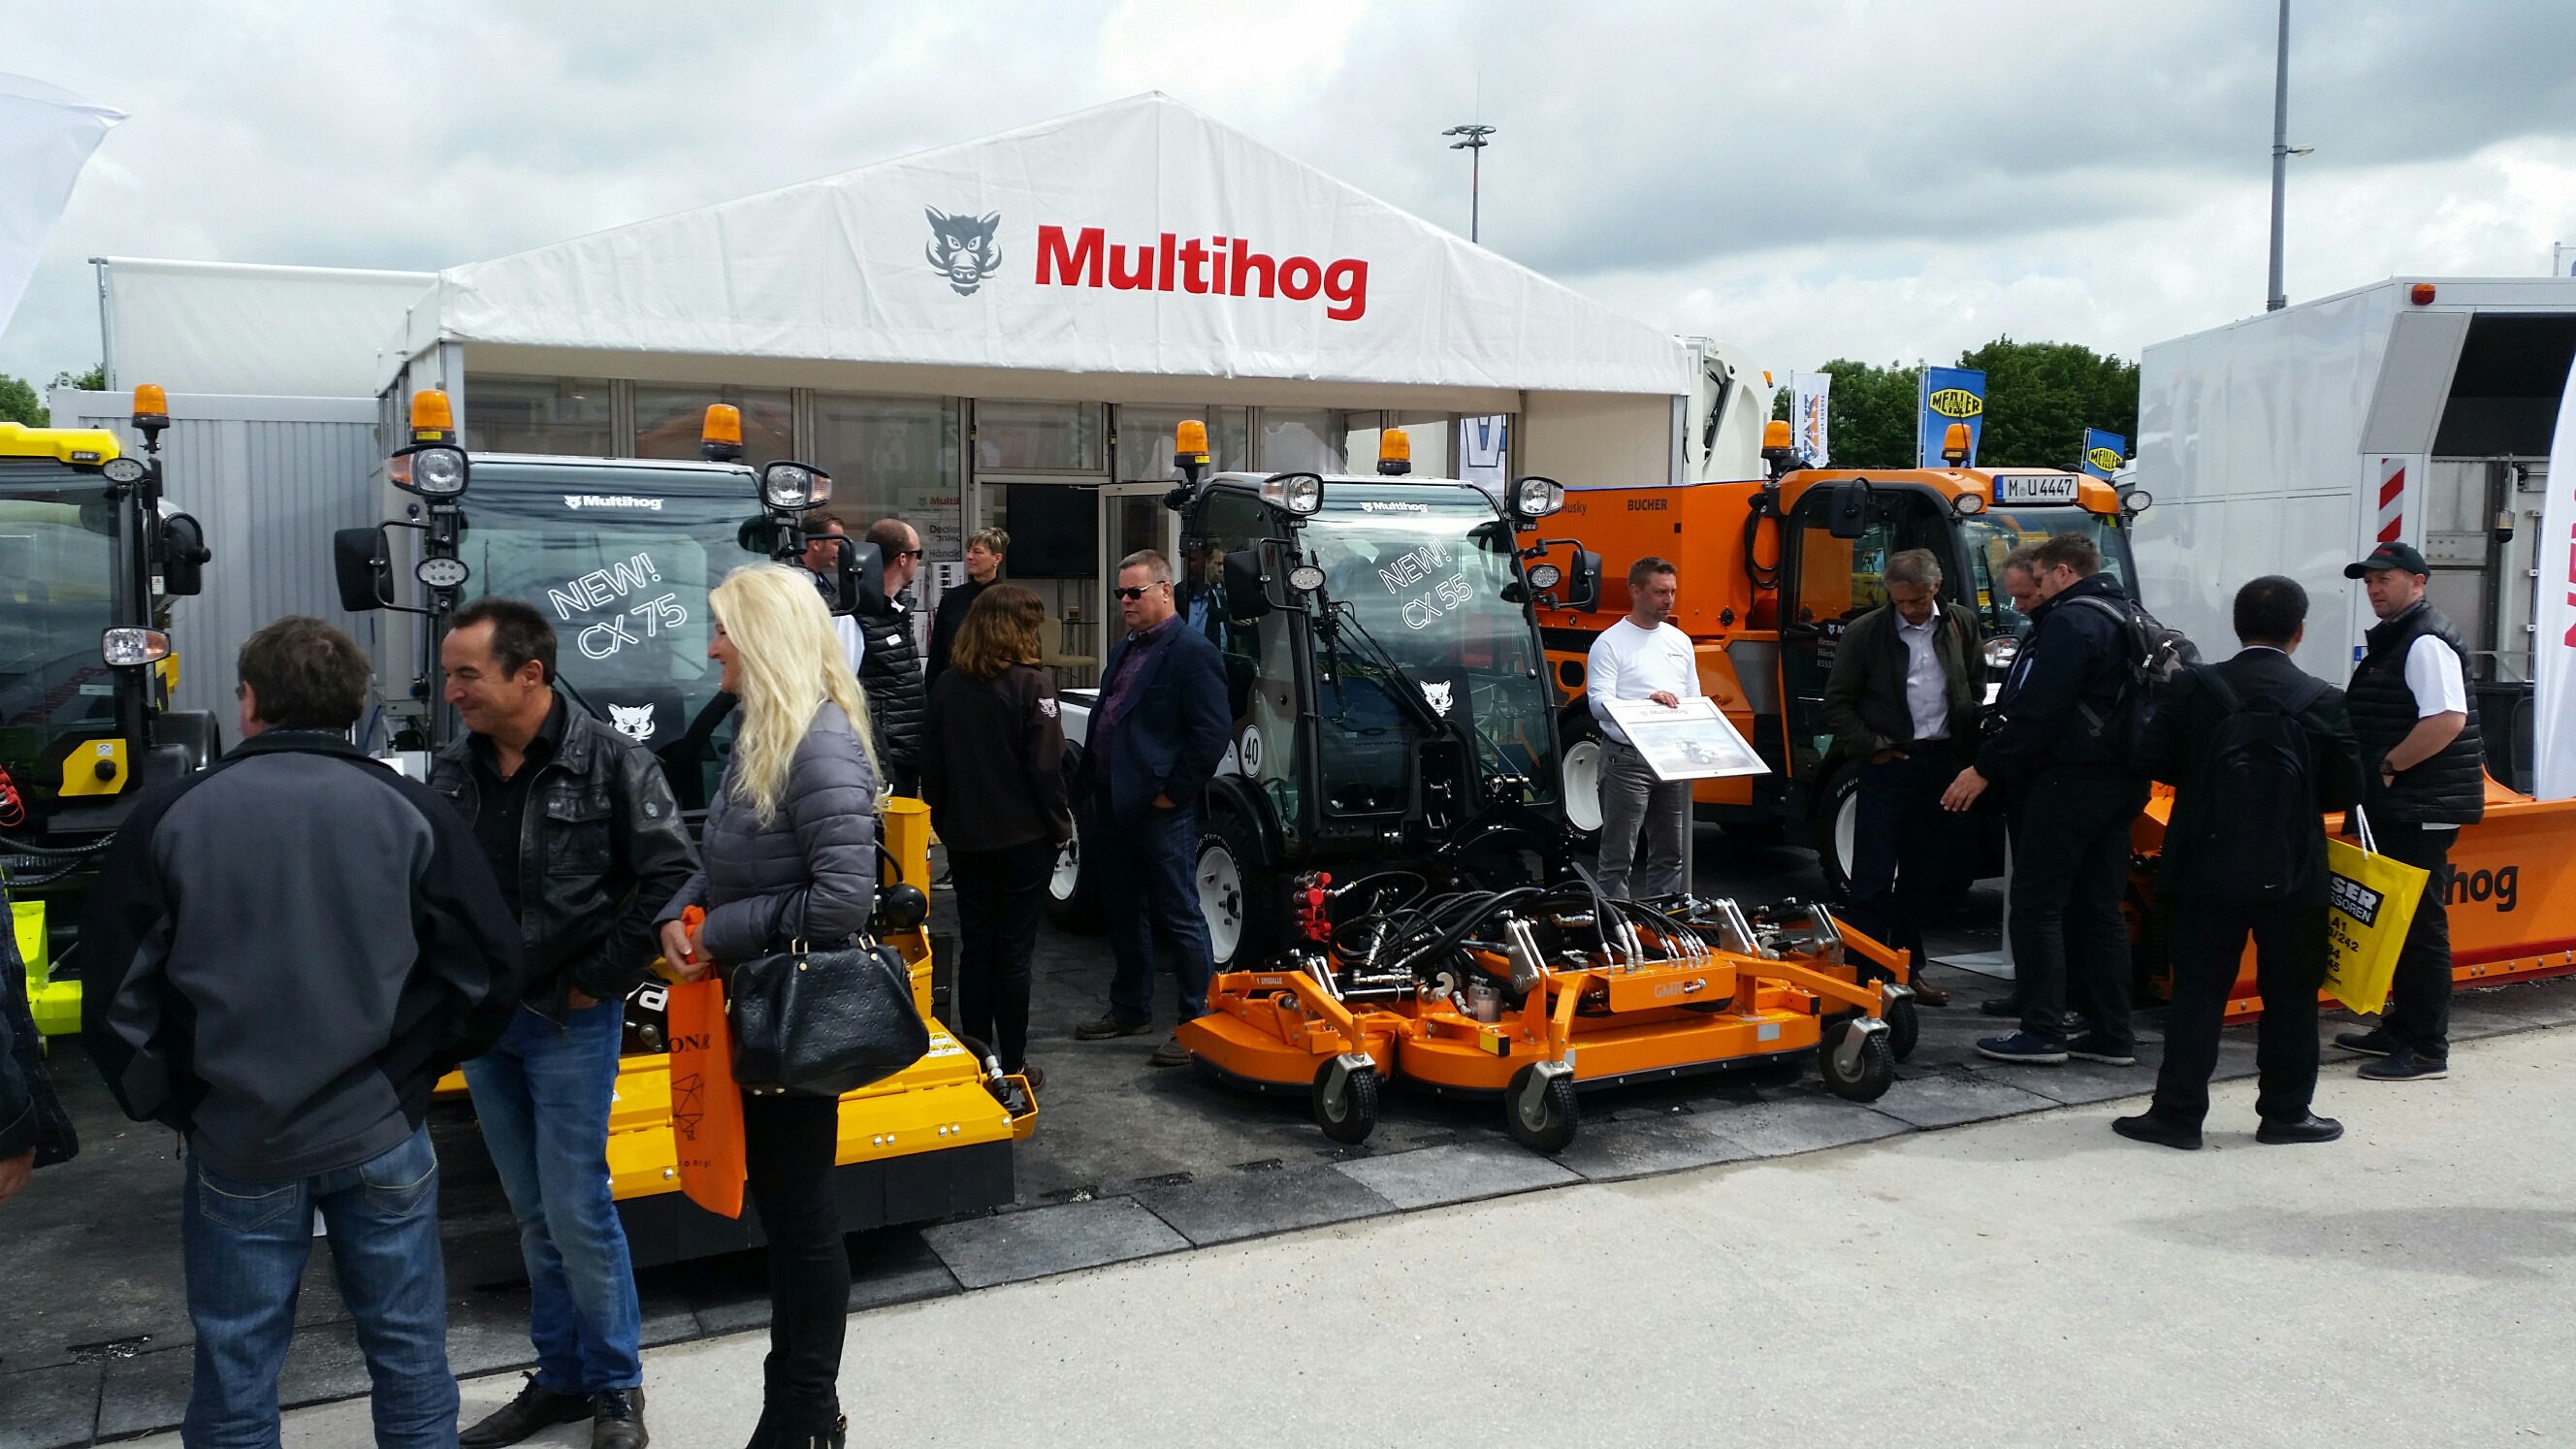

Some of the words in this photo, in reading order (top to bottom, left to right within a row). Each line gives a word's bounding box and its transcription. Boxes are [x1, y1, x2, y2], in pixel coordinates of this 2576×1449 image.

[1035, 224, 1368, 321] Multihog
[583, 496, 663, 510] Multihog
[930, 497, 960, 505] Multi
[1373, 501, 1428, 512] Multihog
[1562, 500, 1587, 516] Husky
[1627, 499, 1667, 511] BUCHER
[1378, 538, 1451, 595] NEW!
[547, 553, 661, 621] NEW!
[1401, 592, 1442, 629] CX
[1435, 572, 1472, 610] 55
[577, 614, 639, 660] CX
[630, 593, 688, 637] 75
[1817, 659, 1834, 668] 8555
[1244, 737, 1259, 765] 40
[2330, 876, 2377, 911] SER
